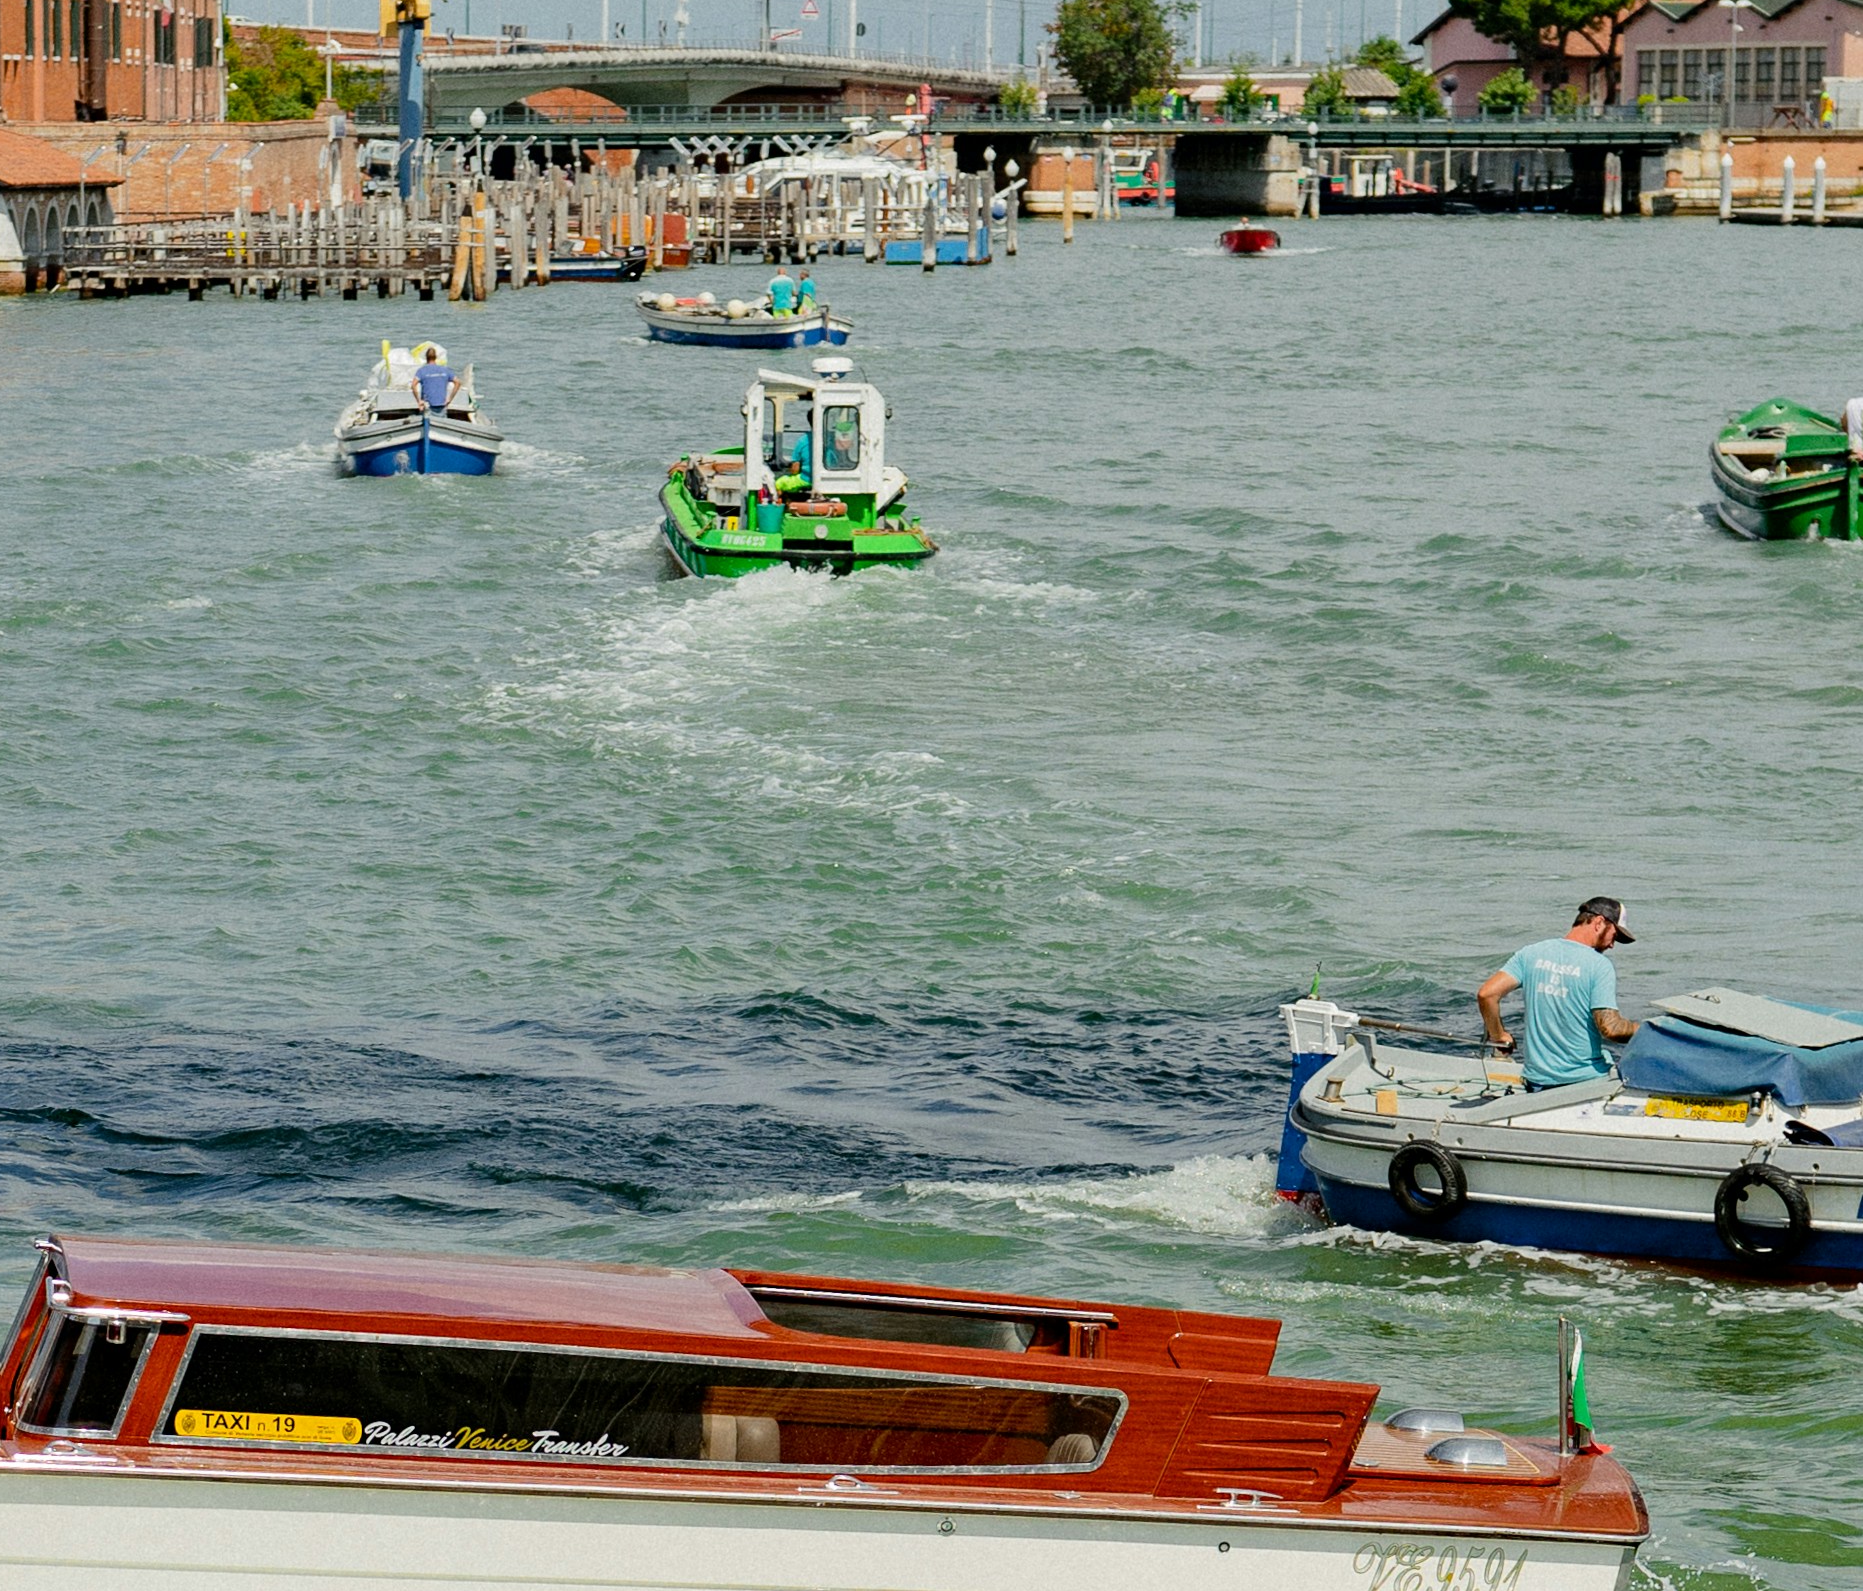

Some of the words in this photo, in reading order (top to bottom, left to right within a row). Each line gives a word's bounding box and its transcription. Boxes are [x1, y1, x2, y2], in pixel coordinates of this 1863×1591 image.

[201, 1412, 251, 1431] TAXI
[272, 1416, 296, 1433] 19
[364, 1420, 456, 1449] Palazzi
[453, 1426, 534, 1453] Venice
[531, 1429, 630, 1458] Transfer
